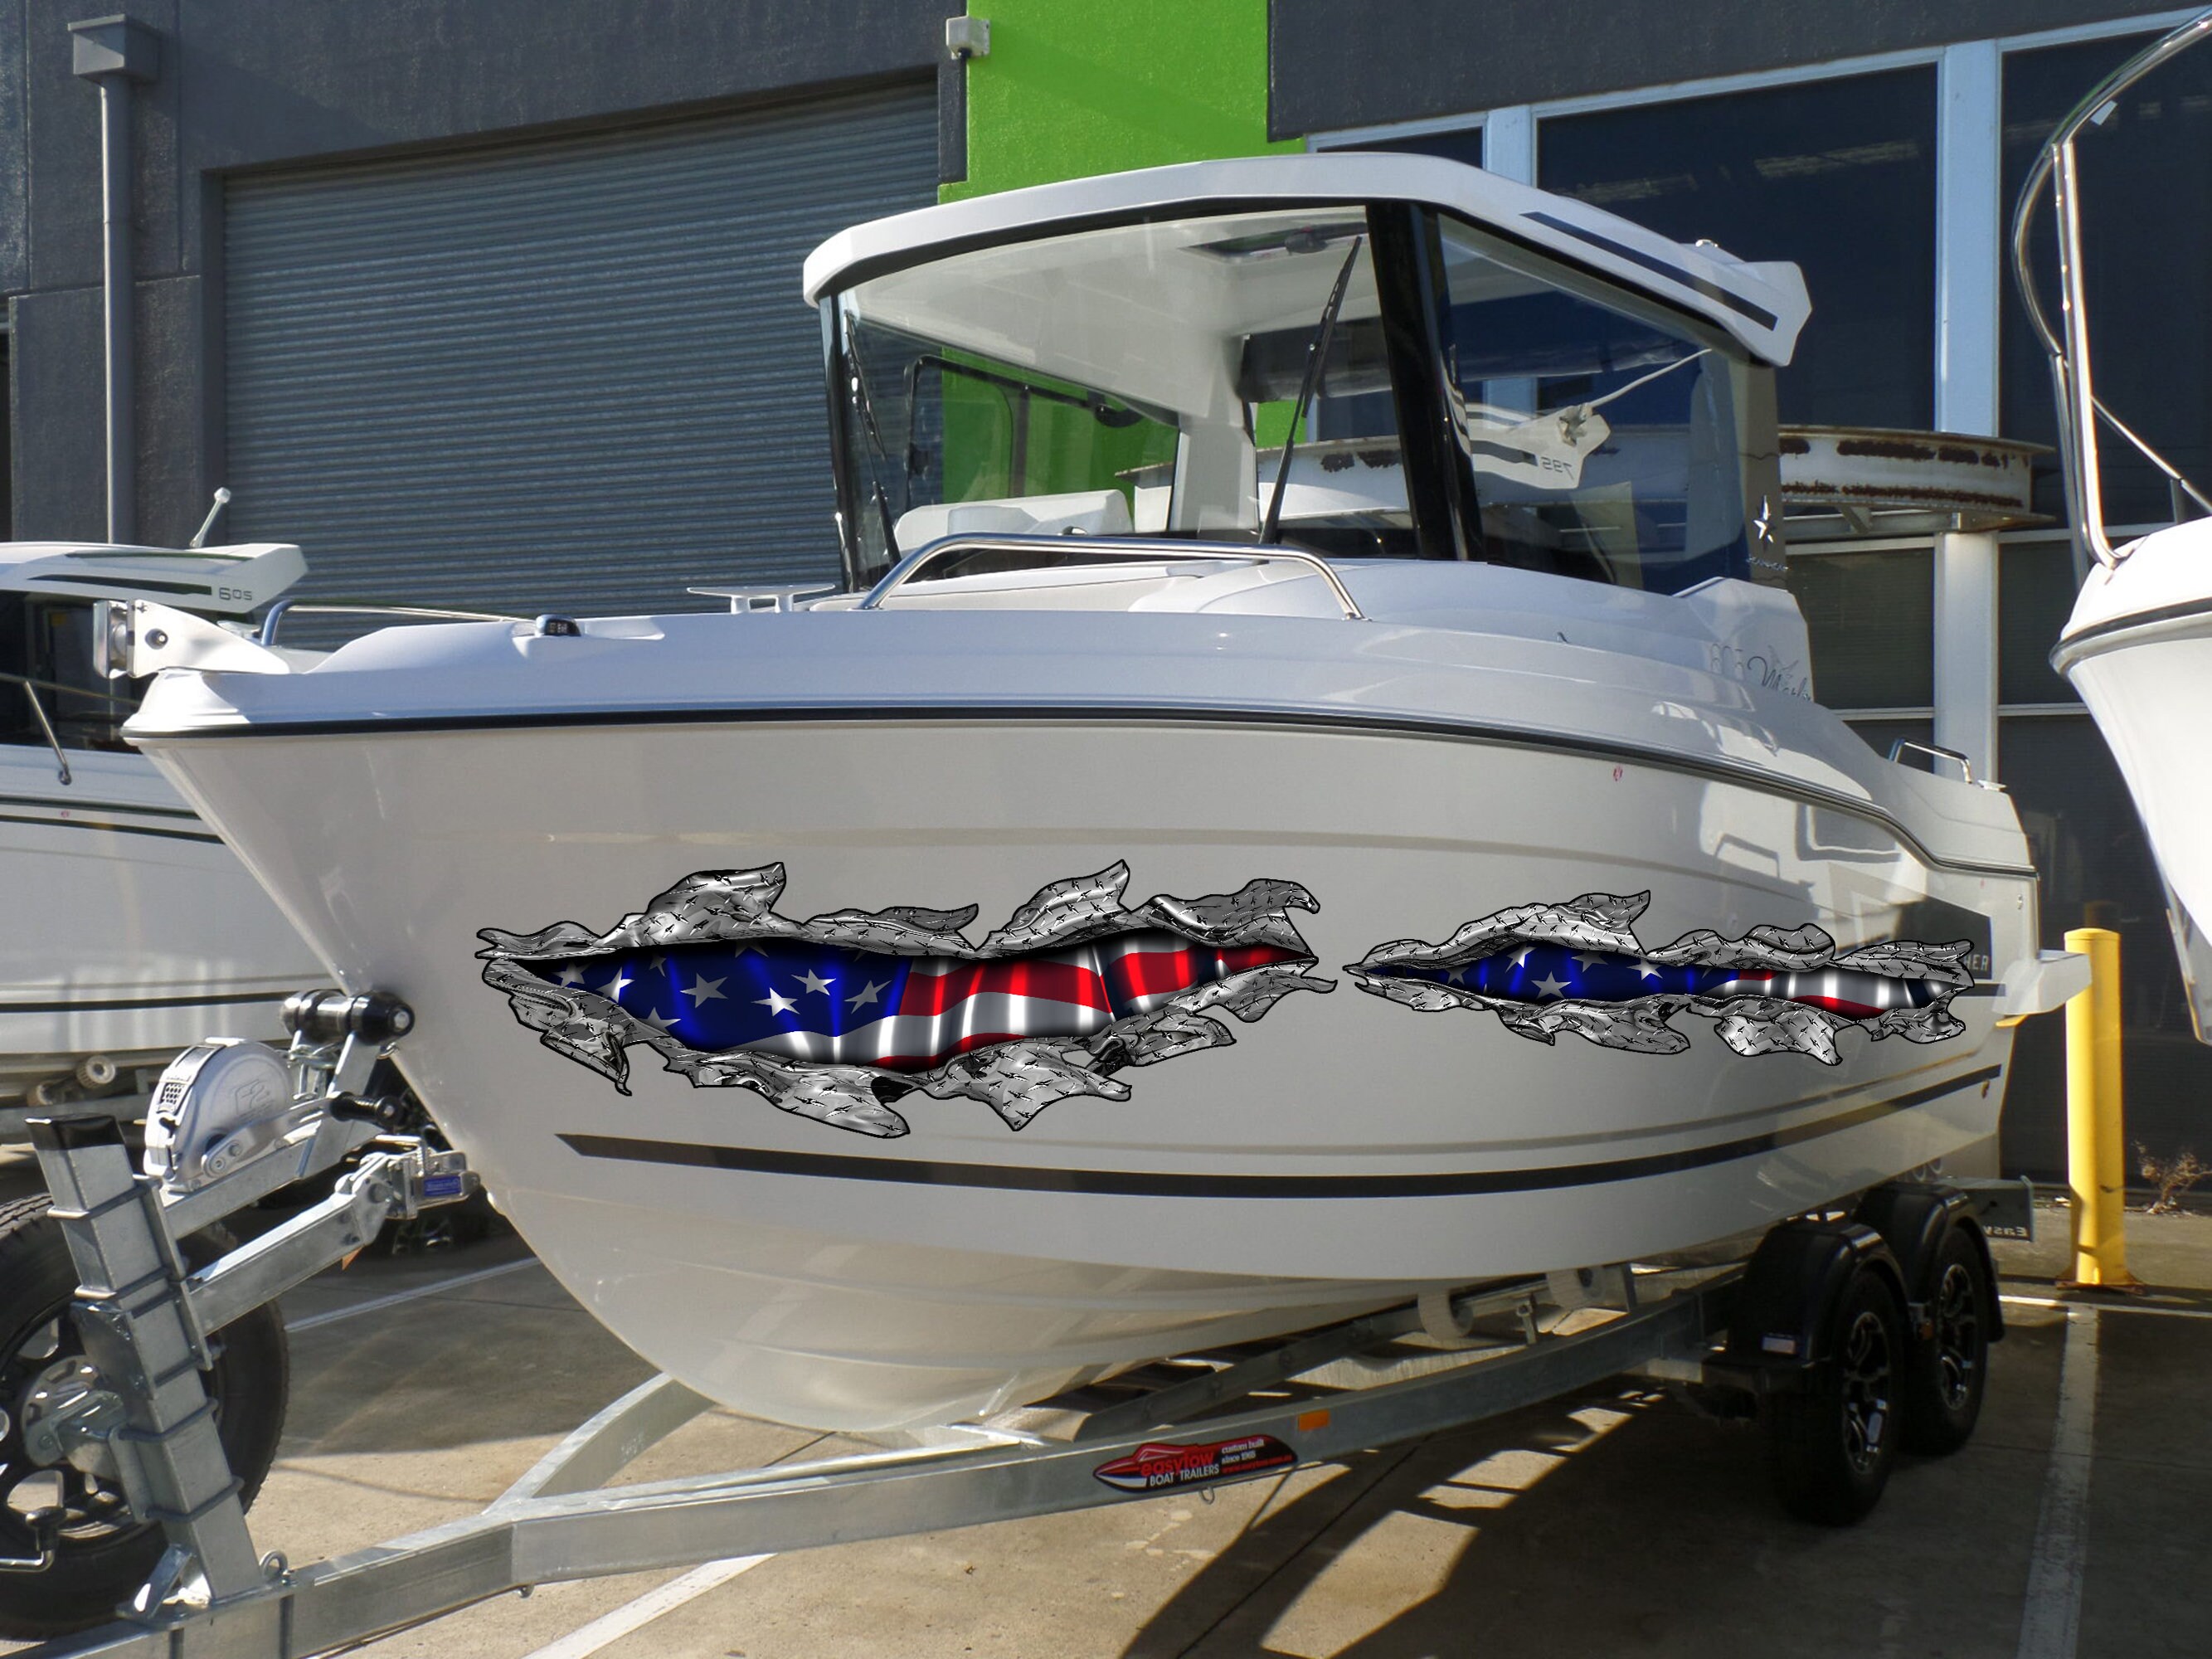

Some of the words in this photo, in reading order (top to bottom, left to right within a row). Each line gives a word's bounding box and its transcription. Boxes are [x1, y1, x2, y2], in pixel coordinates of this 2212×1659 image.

[219, 587, 253, 601] 605
[1140, 1452, 1214, 1477] easytow
[1150, 1472, 1175, 1487] BOAT
[1179, 1463, 1220, 1481] TRAILERS
